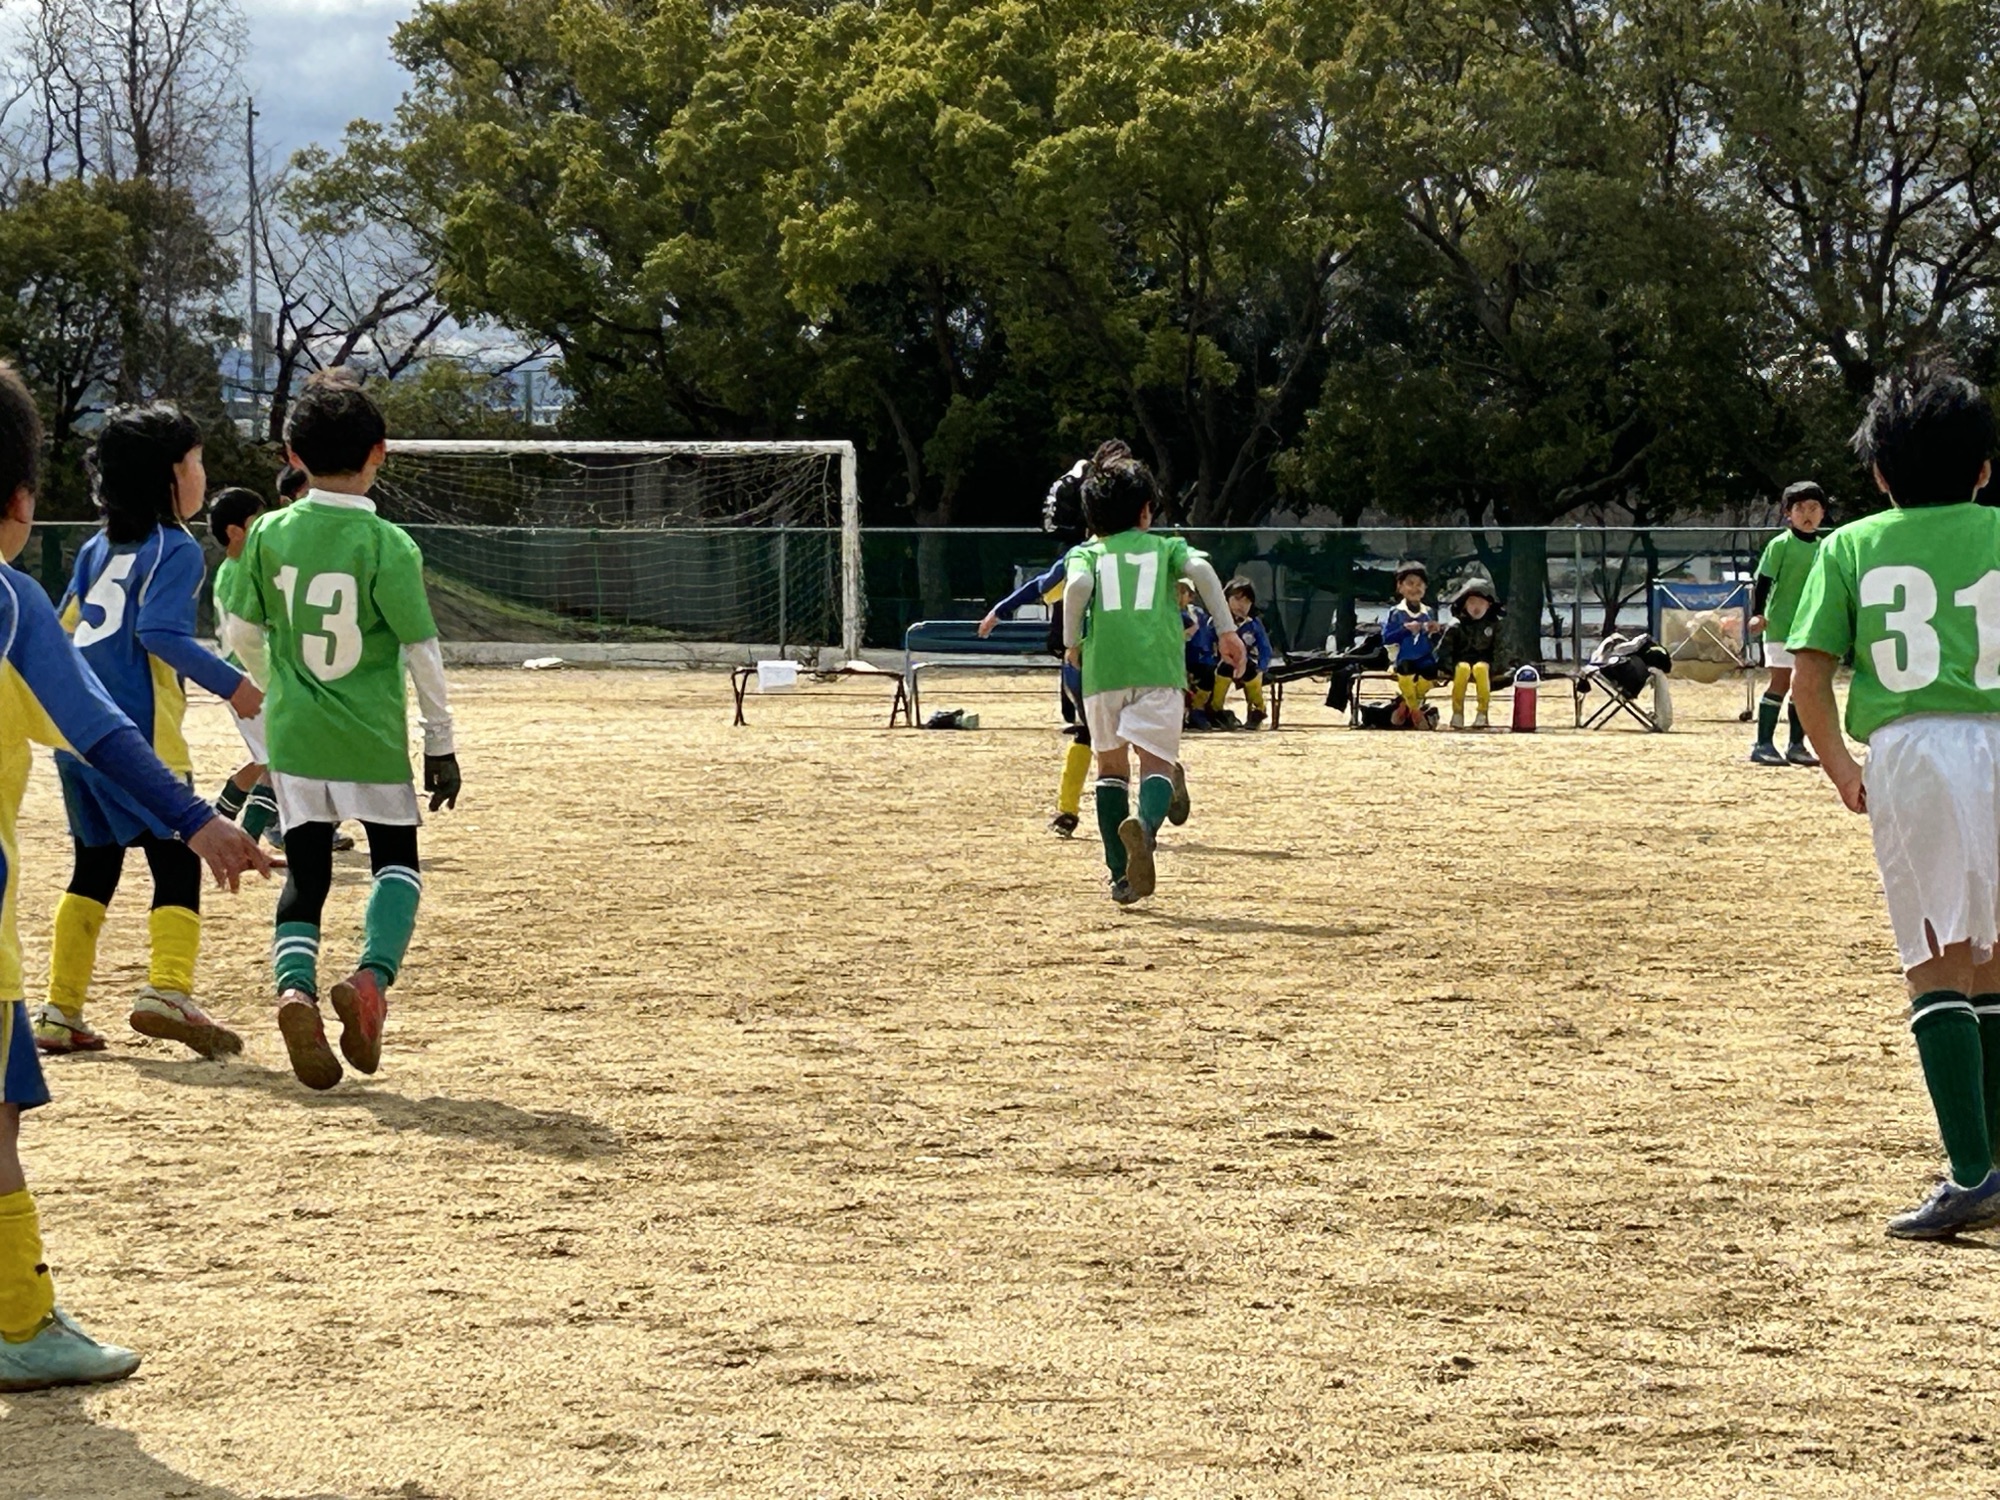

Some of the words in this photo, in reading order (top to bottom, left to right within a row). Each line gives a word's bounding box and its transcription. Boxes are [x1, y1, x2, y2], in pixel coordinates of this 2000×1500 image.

[73, 553, 136, 648] 5
[273, 565, 363, 681] 13
[1096, 551, 1158, 611] 17
[1859, 565, 2000, 693] 31
